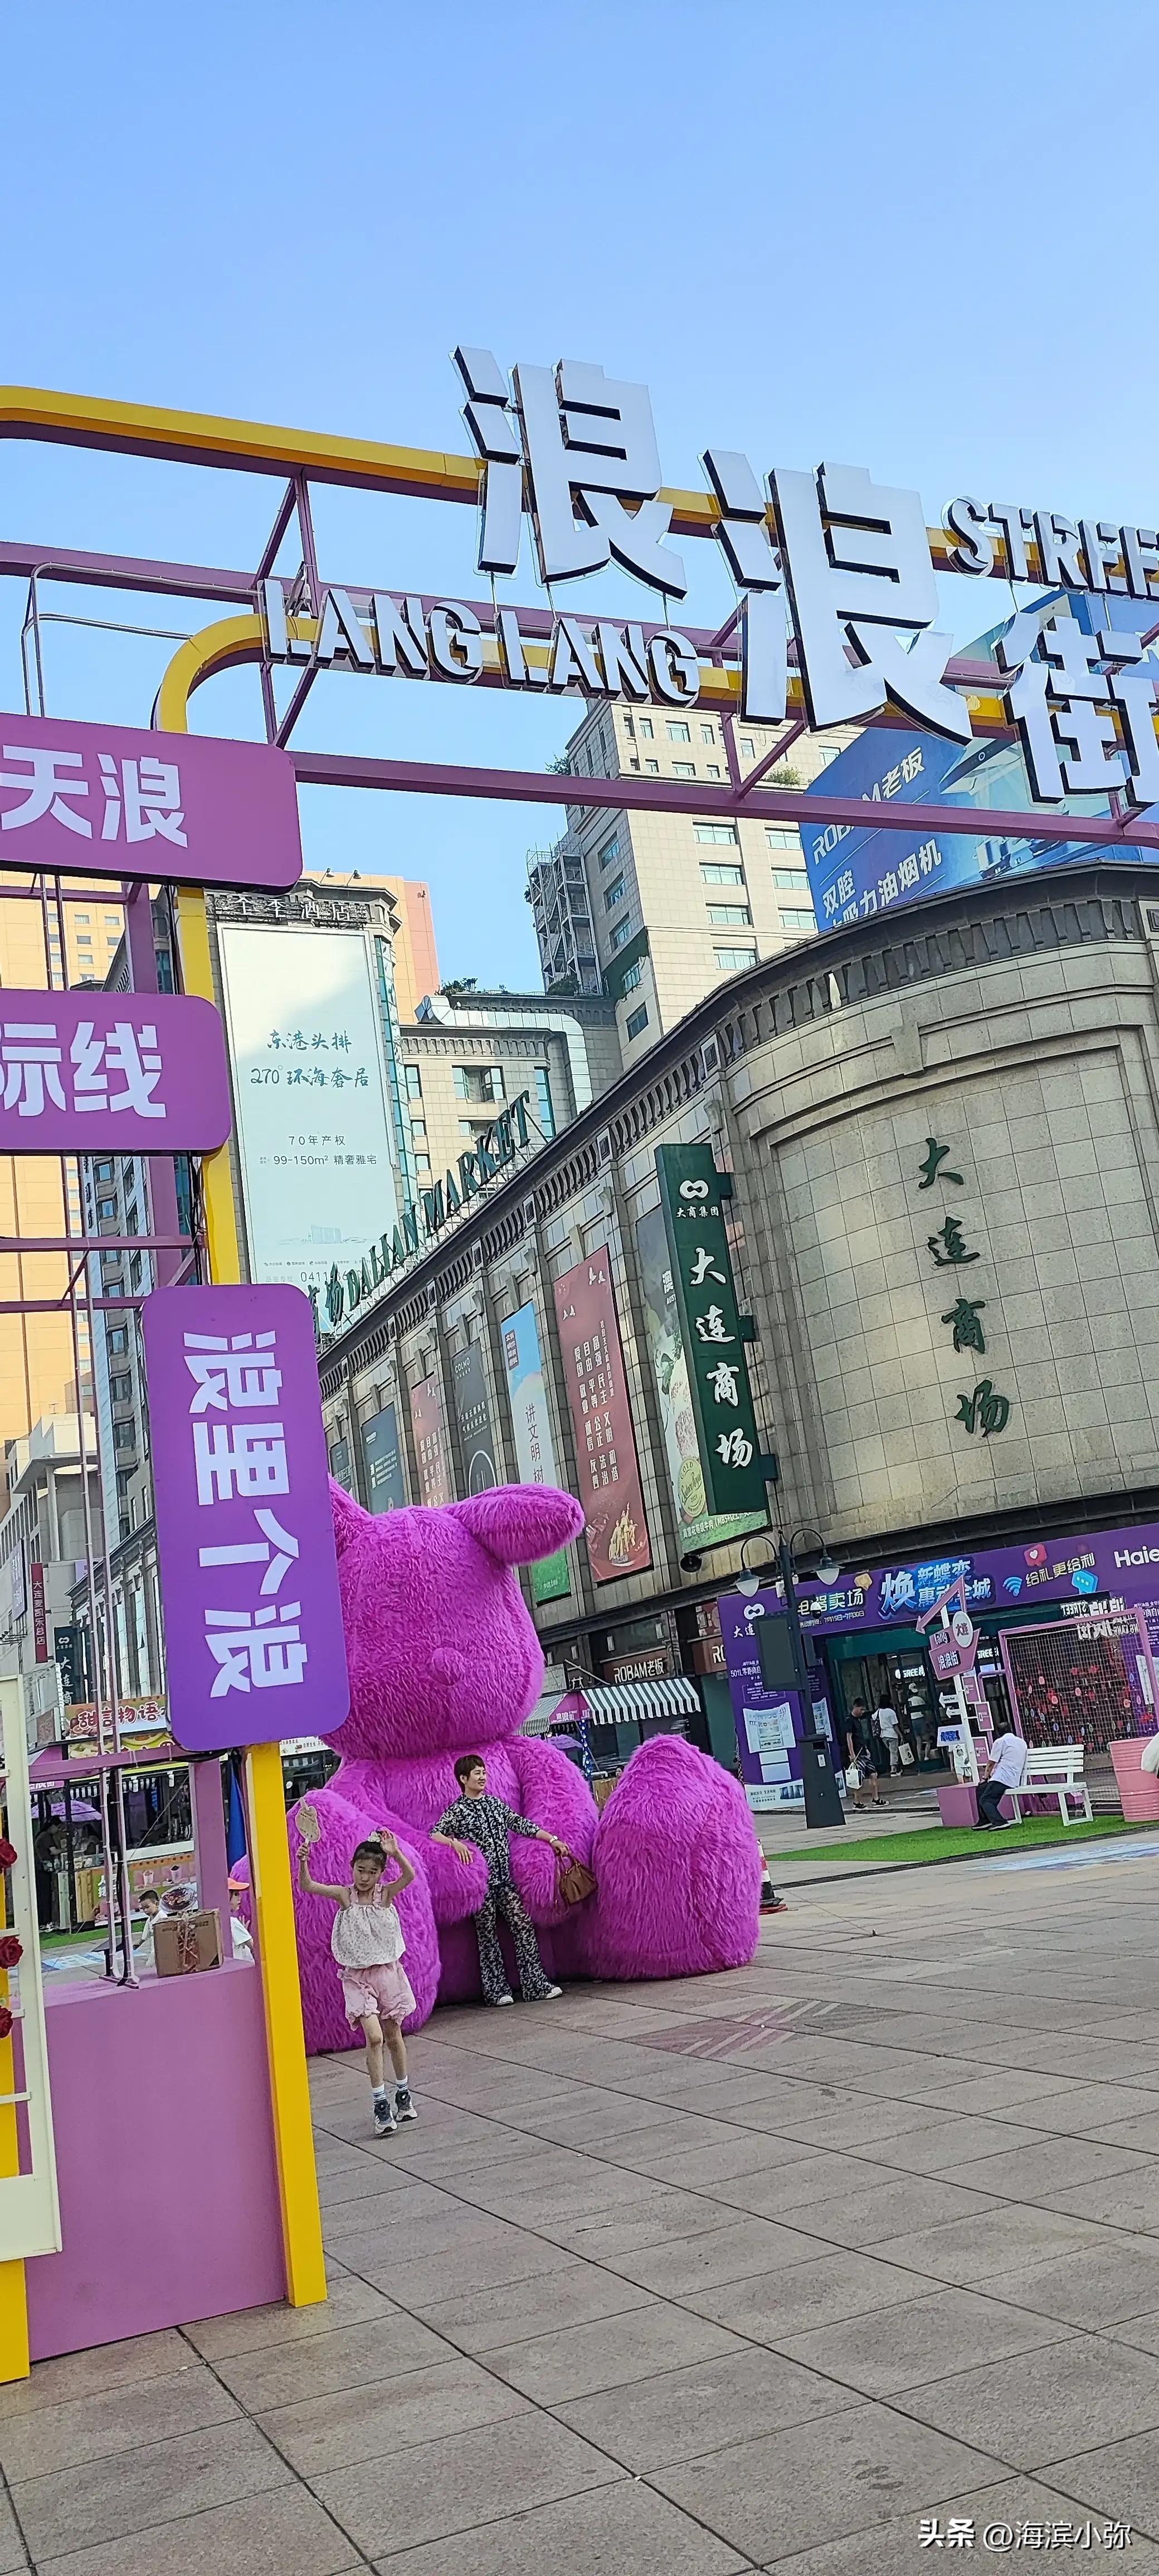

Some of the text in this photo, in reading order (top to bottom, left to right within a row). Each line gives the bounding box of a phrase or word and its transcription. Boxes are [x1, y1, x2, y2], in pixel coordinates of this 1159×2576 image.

[945, 497, 1159, 600] STREE
[262, 578, 700, 707] LANG LANG
[812, 747, 926, 865] ROBM老板
[234, 895, 351, 921] 全季酒店
[822, 869, 856, 919] 双腔
[267, 1029, 352, 1054] 东港头排
[347, 1090, 532, 1313] DALIAN MARKET
[675, 1206, 719, 1219] 大商集团
[918, 1137, 1010, 1438] 大连商场
[690, 1247, 753, 1470] 大连商场
[583, 1341, 593, 1373] 自由
[588, 1377, 598, 1409] 平等
[594, 1415, 604, 1448] 公正
[597, 1372, 608, 1406] 民主
[603, 1411, 613, 1443] 文明
[680, 1461, 693, 1480] GOLD
[183, 1330, 308, 1699] 浪里个浪
[1025, 1552, 1096, 1587] 给礼更给利
[733, 1622, 756, 1638] 大连
[78, 1701, 165, 1730] 甜言物语
